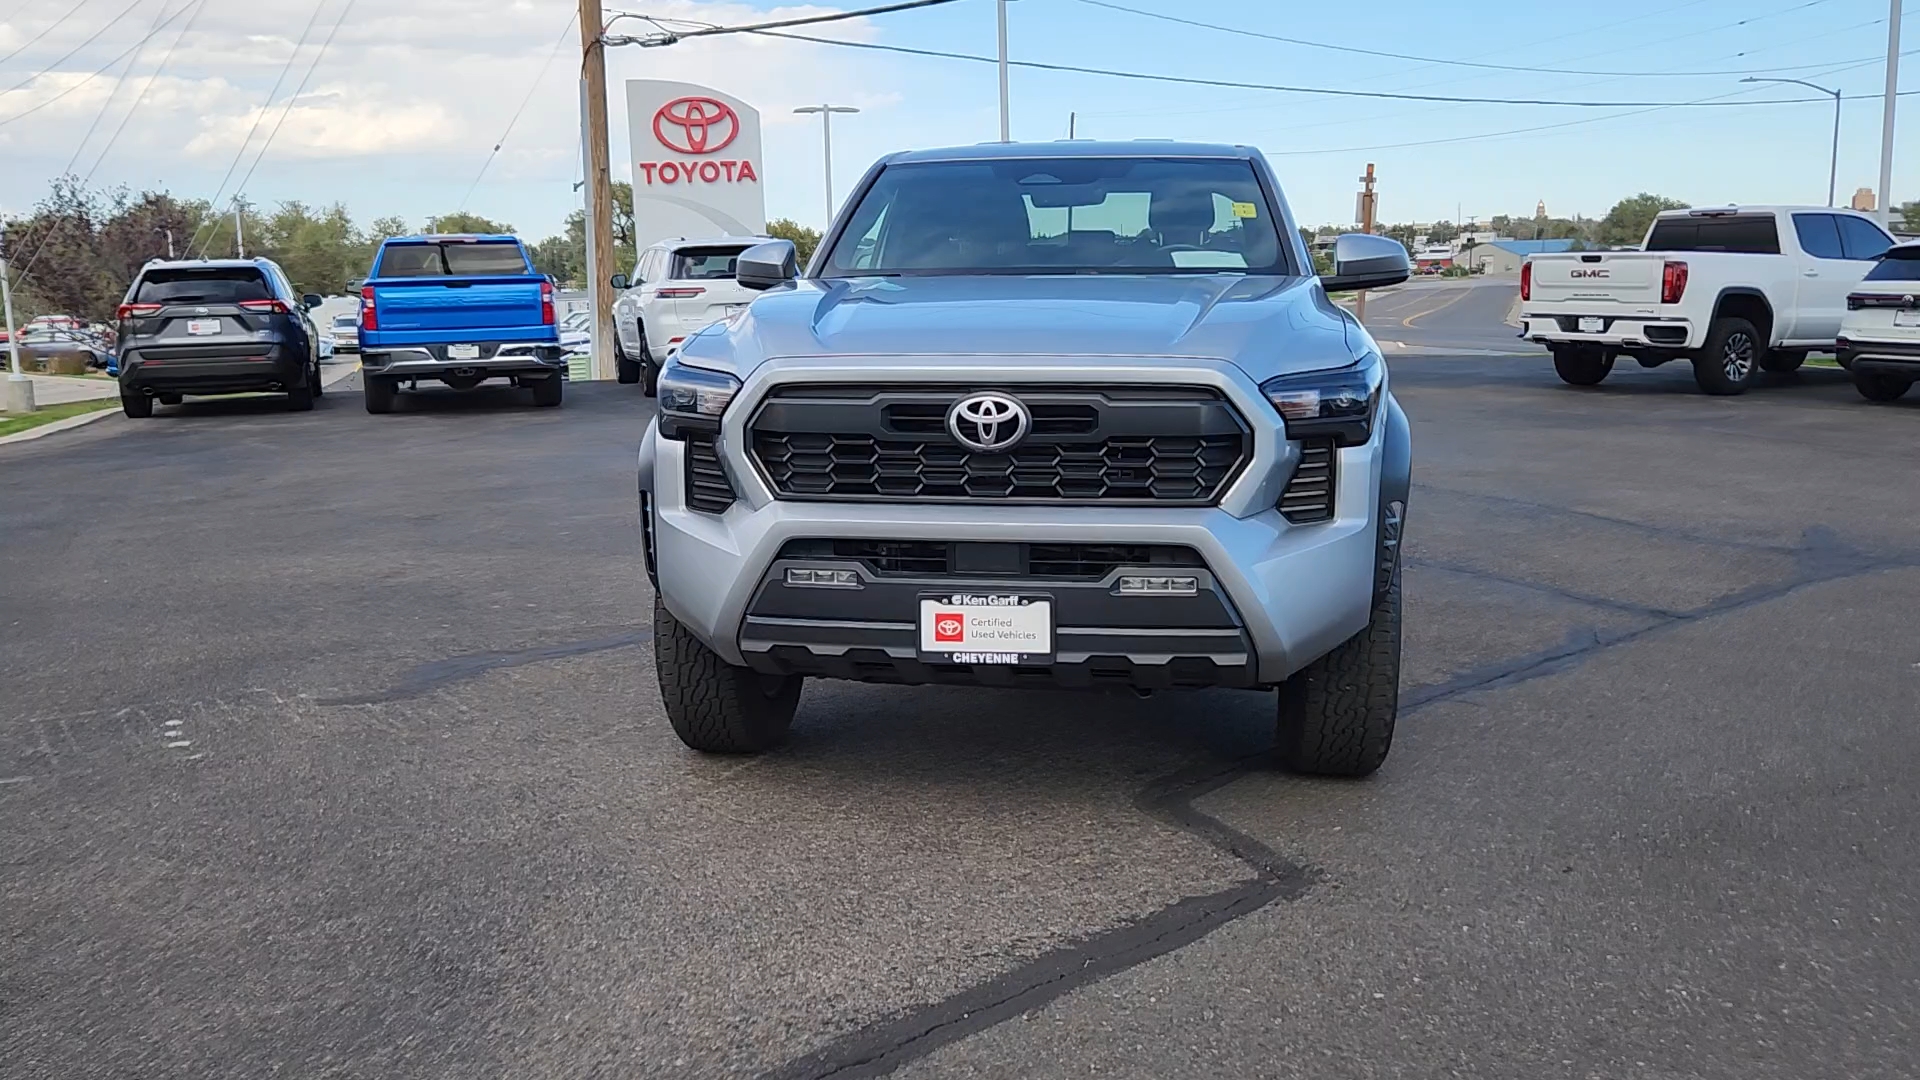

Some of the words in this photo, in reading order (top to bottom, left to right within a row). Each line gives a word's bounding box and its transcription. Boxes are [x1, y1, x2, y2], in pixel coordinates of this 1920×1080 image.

[640, 161, 758, 185] TOYOTA
[1571, 269, 1610, 279] GMC
[962, 595, 987, 606] Ken
[987, 595, 1019, 606] Garff
[971, 618, 1012, 628] Certified
[971, 630, 995, 640] Used
[997, 631, 1037, 640] Vehicles
[952, 652, 1019, 665] CHEYENNE
